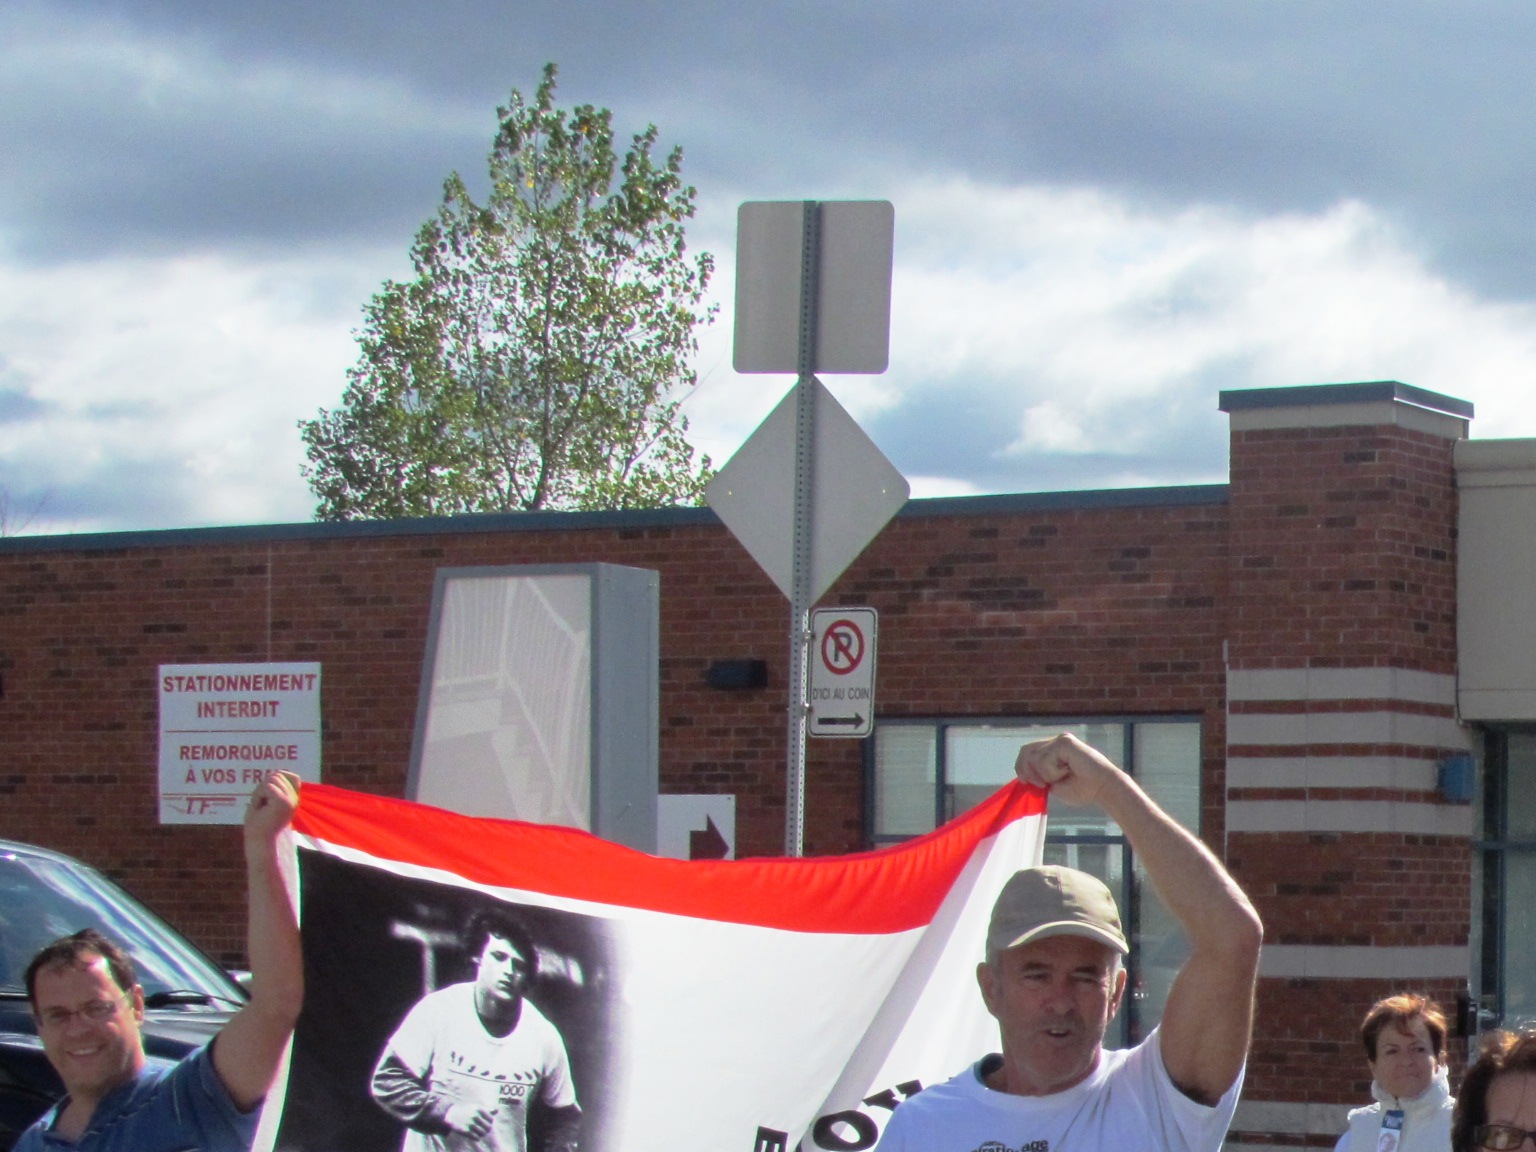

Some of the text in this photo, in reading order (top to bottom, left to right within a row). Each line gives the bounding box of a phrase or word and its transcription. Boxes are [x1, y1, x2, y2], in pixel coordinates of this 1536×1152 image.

[163, 673, 317, 692] STATIONNEMENT
[812, 687, 870, 700] D'ICI AU COIN
[197, 700, 280, 718] INTERDIT
[179, 745, 299, 761] REMORQUAGE
[185, 764, 197, 784] À
[202, 768, 237, 784] VOS
